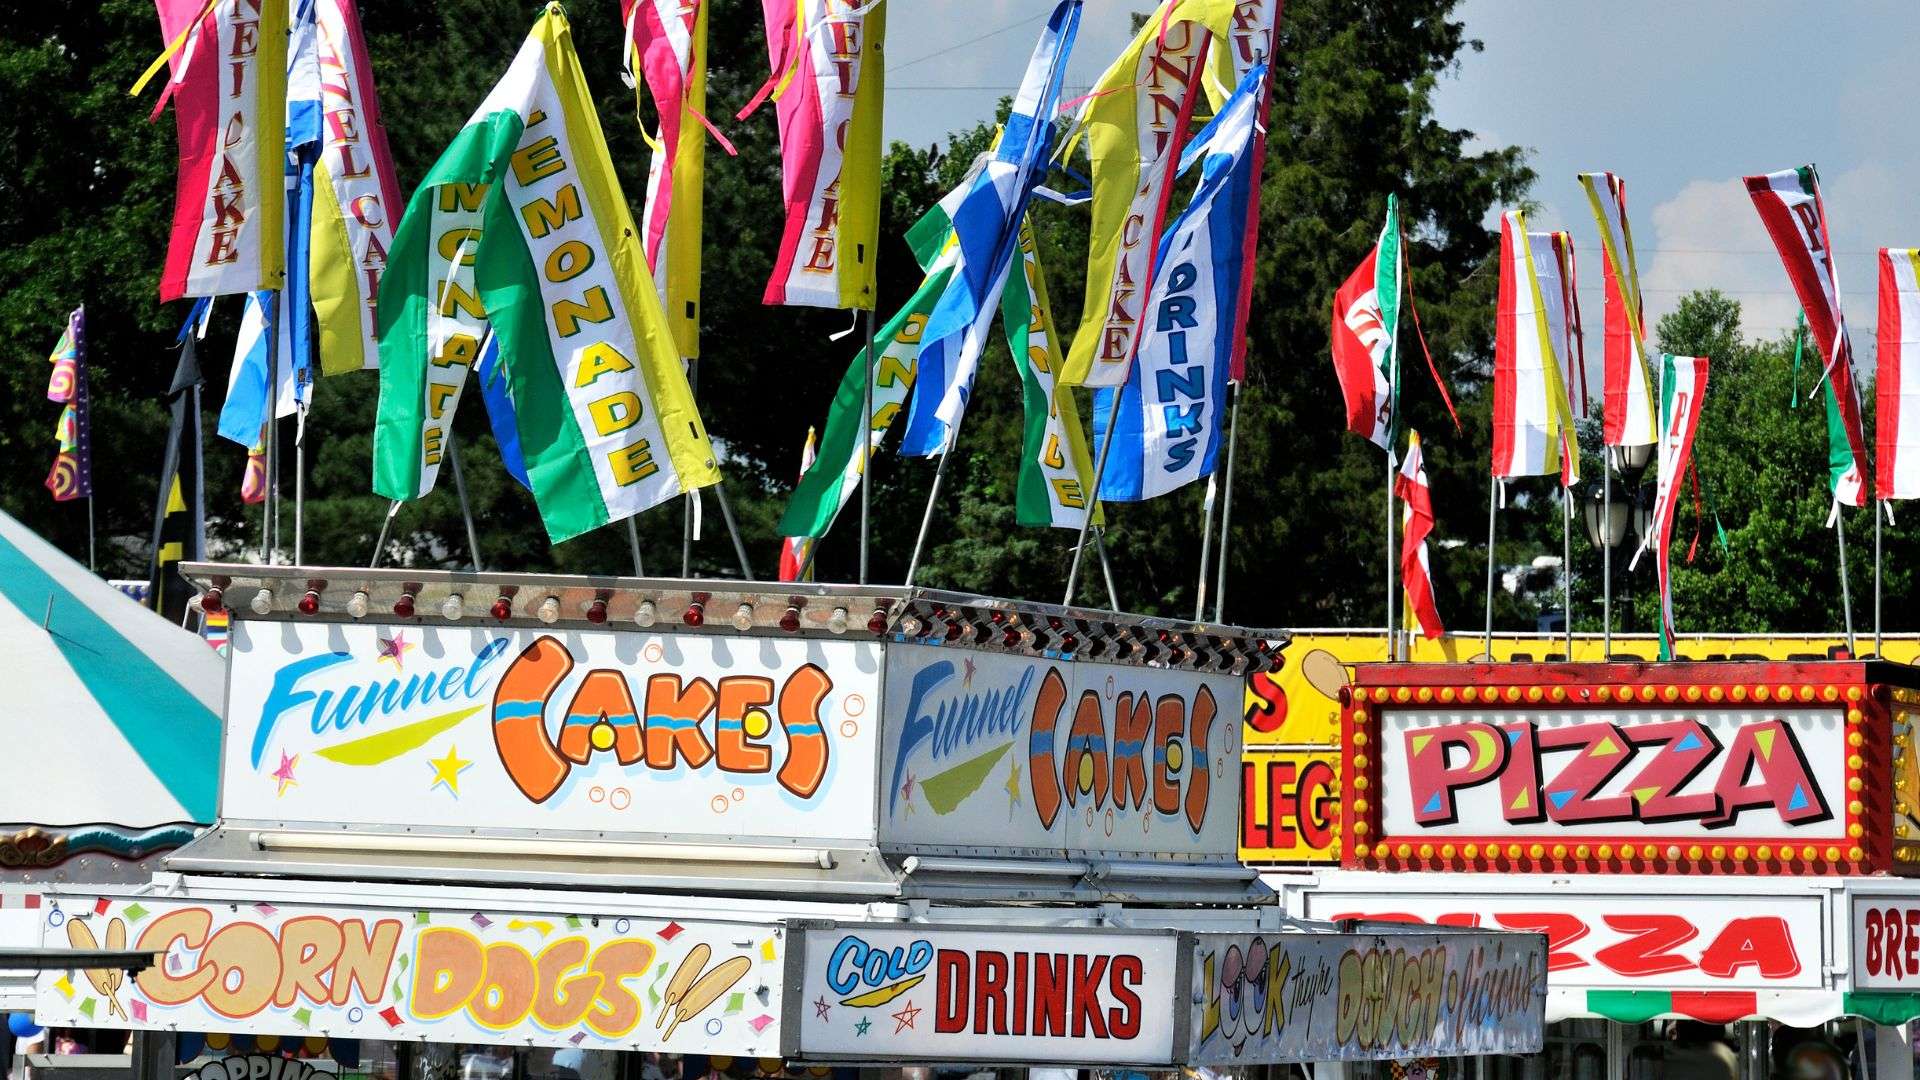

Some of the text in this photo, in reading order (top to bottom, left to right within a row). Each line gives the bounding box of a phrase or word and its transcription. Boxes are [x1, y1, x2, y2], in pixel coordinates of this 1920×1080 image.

[251, 635, 833, 804] Funnel CAKES
[890, 664, 1218, 835] Funnel CAKES
[1404, 718, 1835, 831] PIZZA
[134, 908, 657, 1038] CORN DOGS
[935, 949, 1144, 1040] DRINKS
